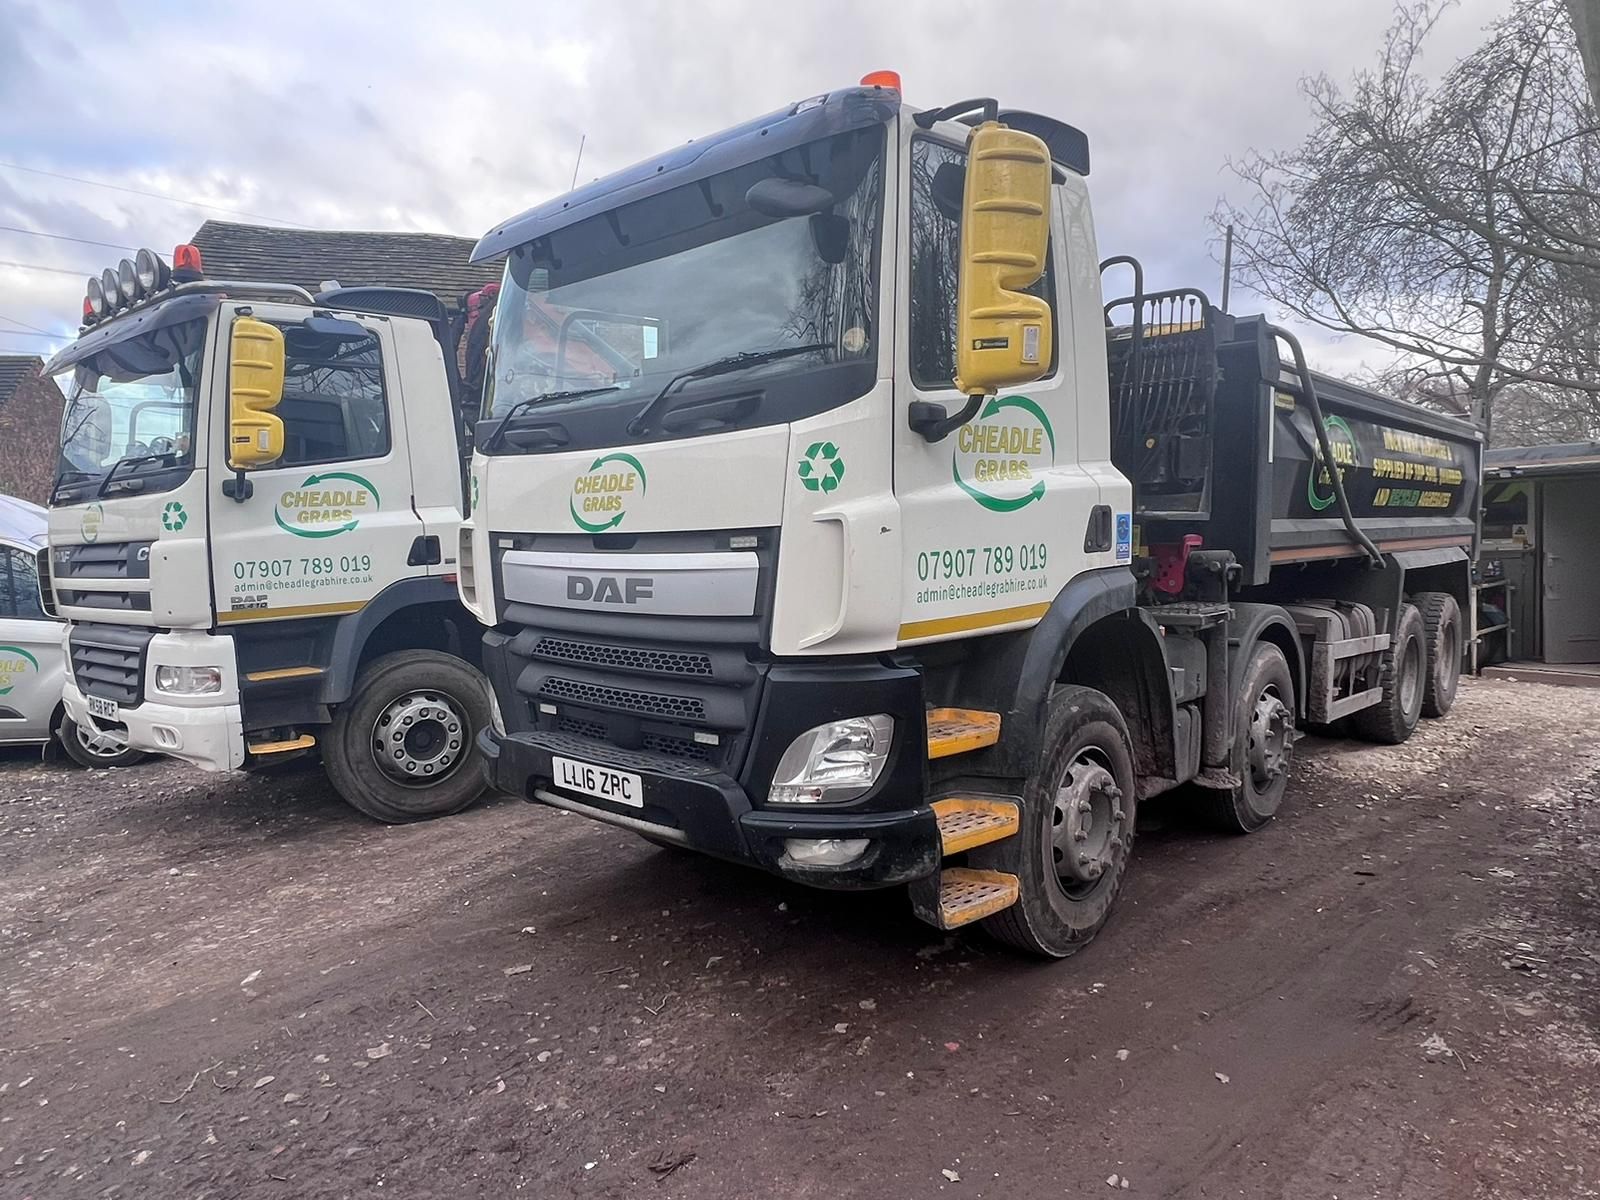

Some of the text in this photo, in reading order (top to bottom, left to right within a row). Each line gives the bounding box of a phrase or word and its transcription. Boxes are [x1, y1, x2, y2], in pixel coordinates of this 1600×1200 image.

[958, 423, 1043, 455] CHEADLE
[975, 459, 1033, 483] GRABS
[574, 472, 637, 495] CHEADLE
[280, 490, 368, 509] CHEADLE
[583, 495, 623, 512] GRABS
[296, 509, 353, 524] GRABS
[234, 555, 371, 580] 07907 789 019
[918, 543, 1047, 581] 07907 789 019
[234, 574, 374, 593] admin@cheadlegrabhire.co.uk
[566, 575, 655, 604] DAF
[917, 575, 1048, 603] admin@cheadlegrabhire.co.uk
[230, 594, 268, 604] DAF
[562, 762, 631, 800] LL16 ZPC
